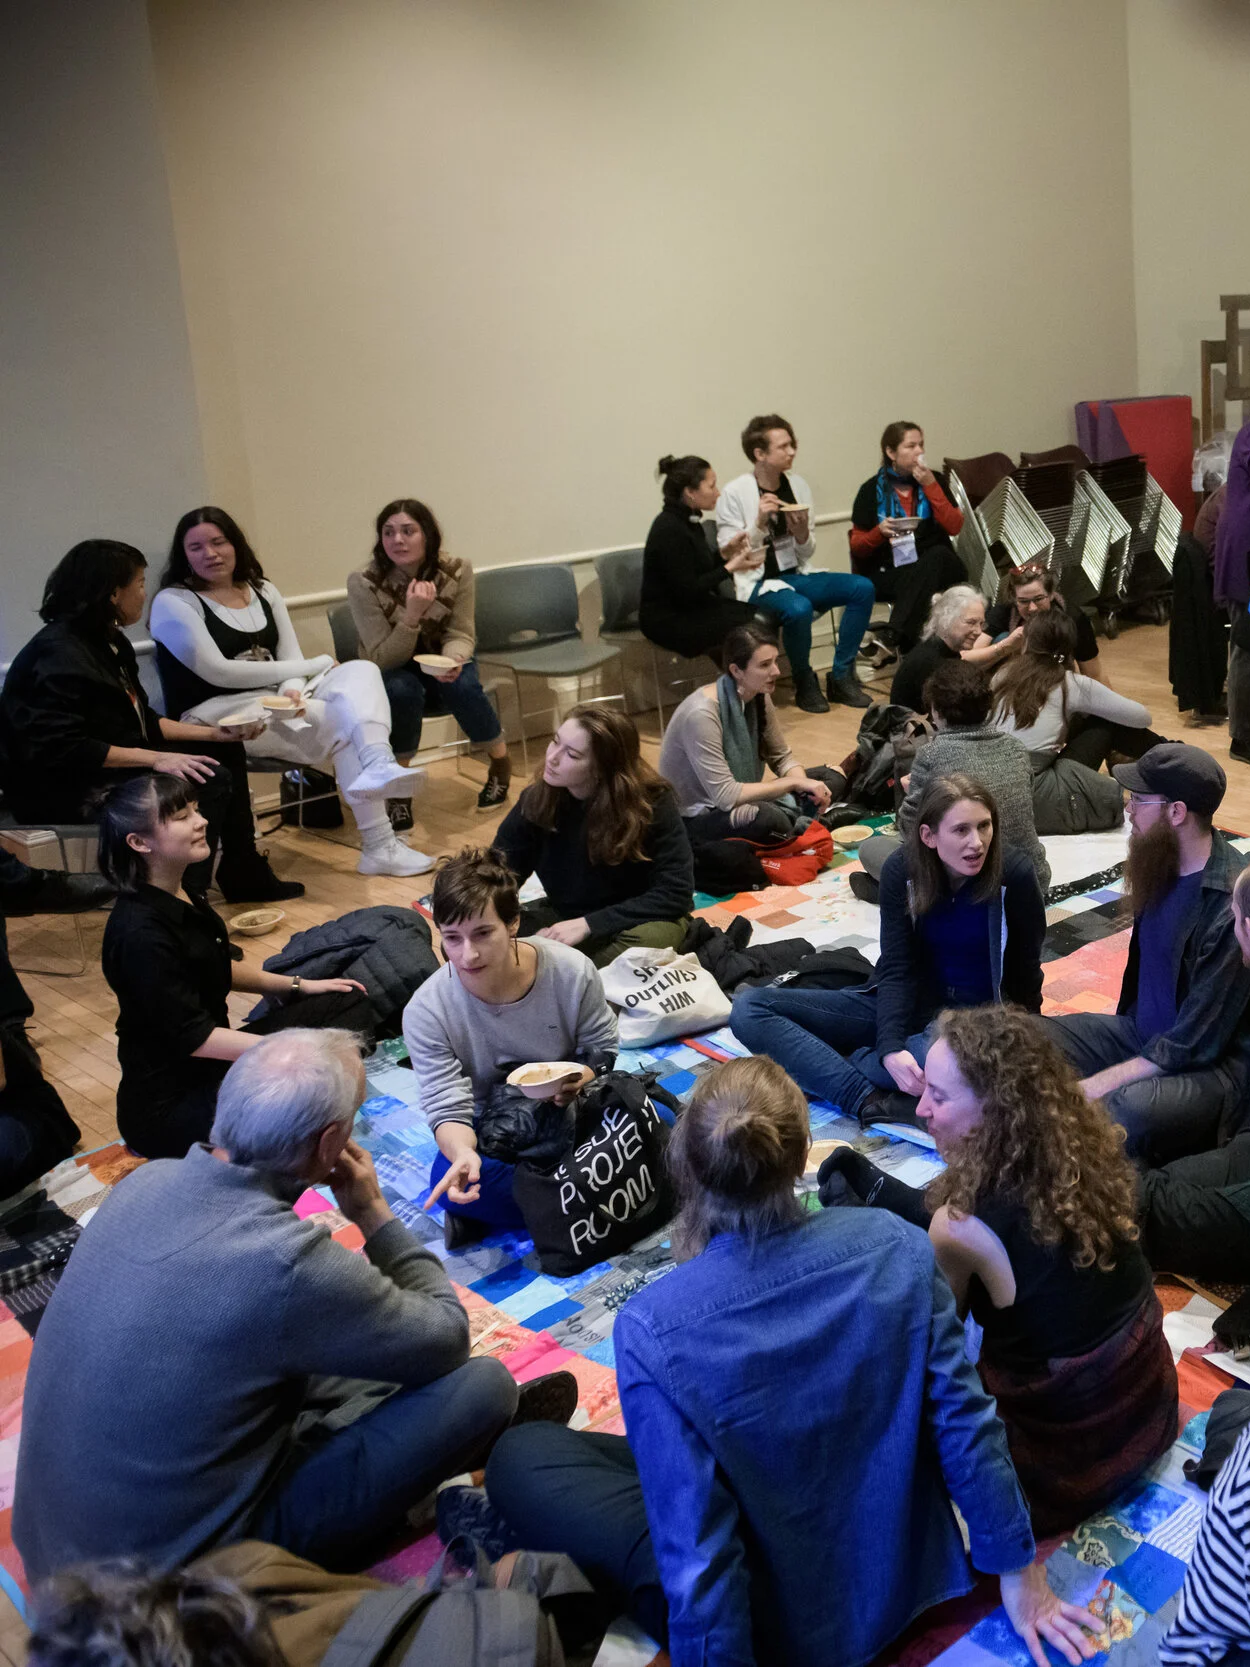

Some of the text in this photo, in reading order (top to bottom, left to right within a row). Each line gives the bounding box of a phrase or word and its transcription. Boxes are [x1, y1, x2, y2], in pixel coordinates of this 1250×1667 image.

[625, 969, 698, 1008] OUTLIVES
[633, 966, 660, 983] SH
[659, 991, 697, 1014] HIM
[570, 1163, 656, 1256] ROOM
